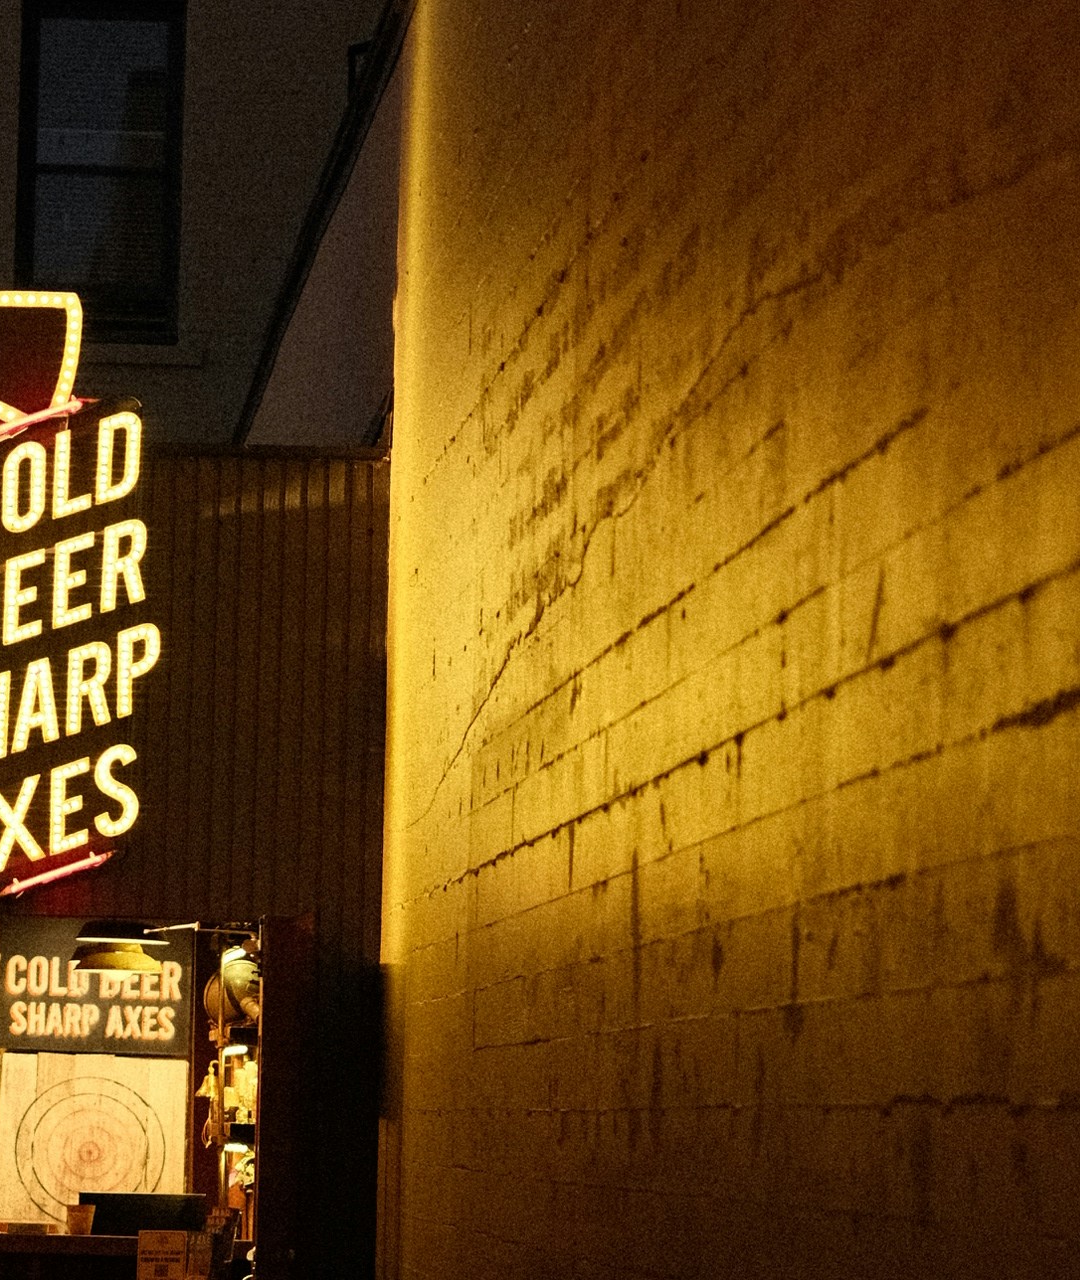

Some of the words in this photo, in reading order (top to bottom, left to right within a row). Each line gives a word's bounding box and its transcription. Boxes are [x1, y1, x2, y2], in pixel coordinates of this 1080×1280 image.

[6, 955, 90, 998] COLD
[9, 1000, 100, 1038] SHARP
[104, 1005, 176, 1041] AXES
